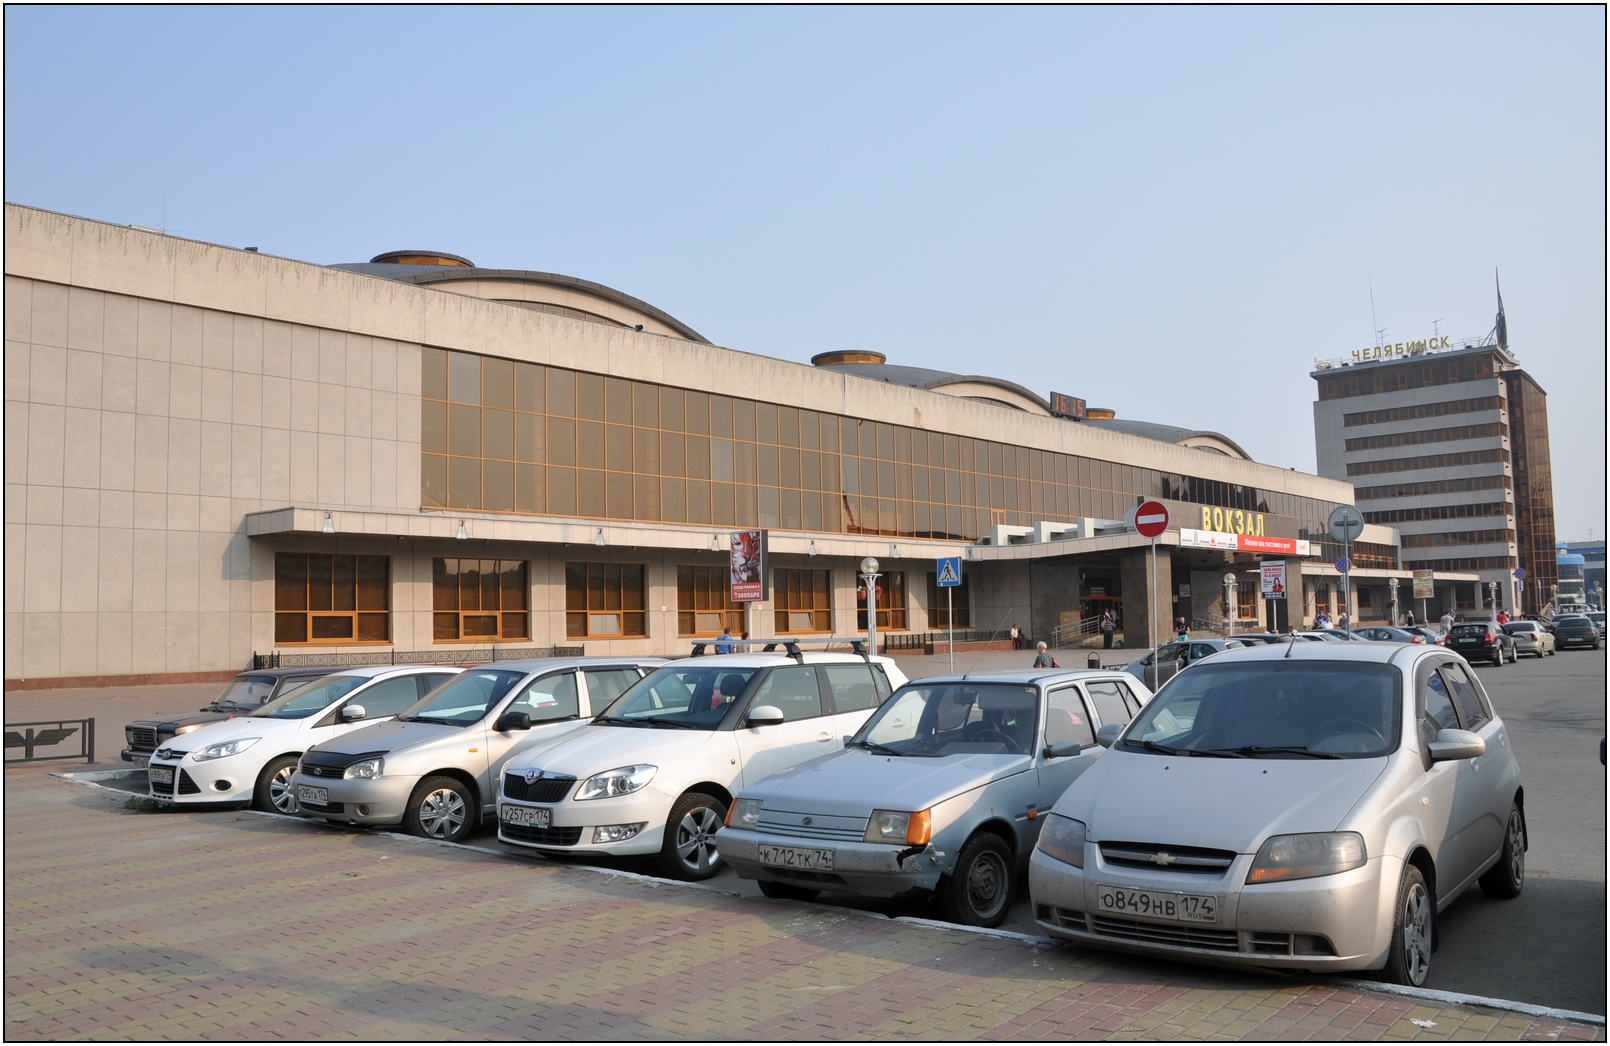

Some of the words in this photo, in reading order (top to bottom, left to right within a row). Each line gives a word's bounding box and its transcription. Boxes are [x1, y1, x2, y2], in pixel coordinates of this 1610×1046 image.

[1352, 336, 1450, 361] ЧЕЛЯБИНСК
[1055, 394, 1083, 417] 16:15
[1201, 506, 1265, 537] ВОКЗАЛ
[504, 807, 534, 822] У257СР
[536, 810, 549, 821] 174
[763, 847, 812, 867] К712ТК
[1103, 890, 1176, 916] О849НВ
[1180, 896, 1211, 913] 174
